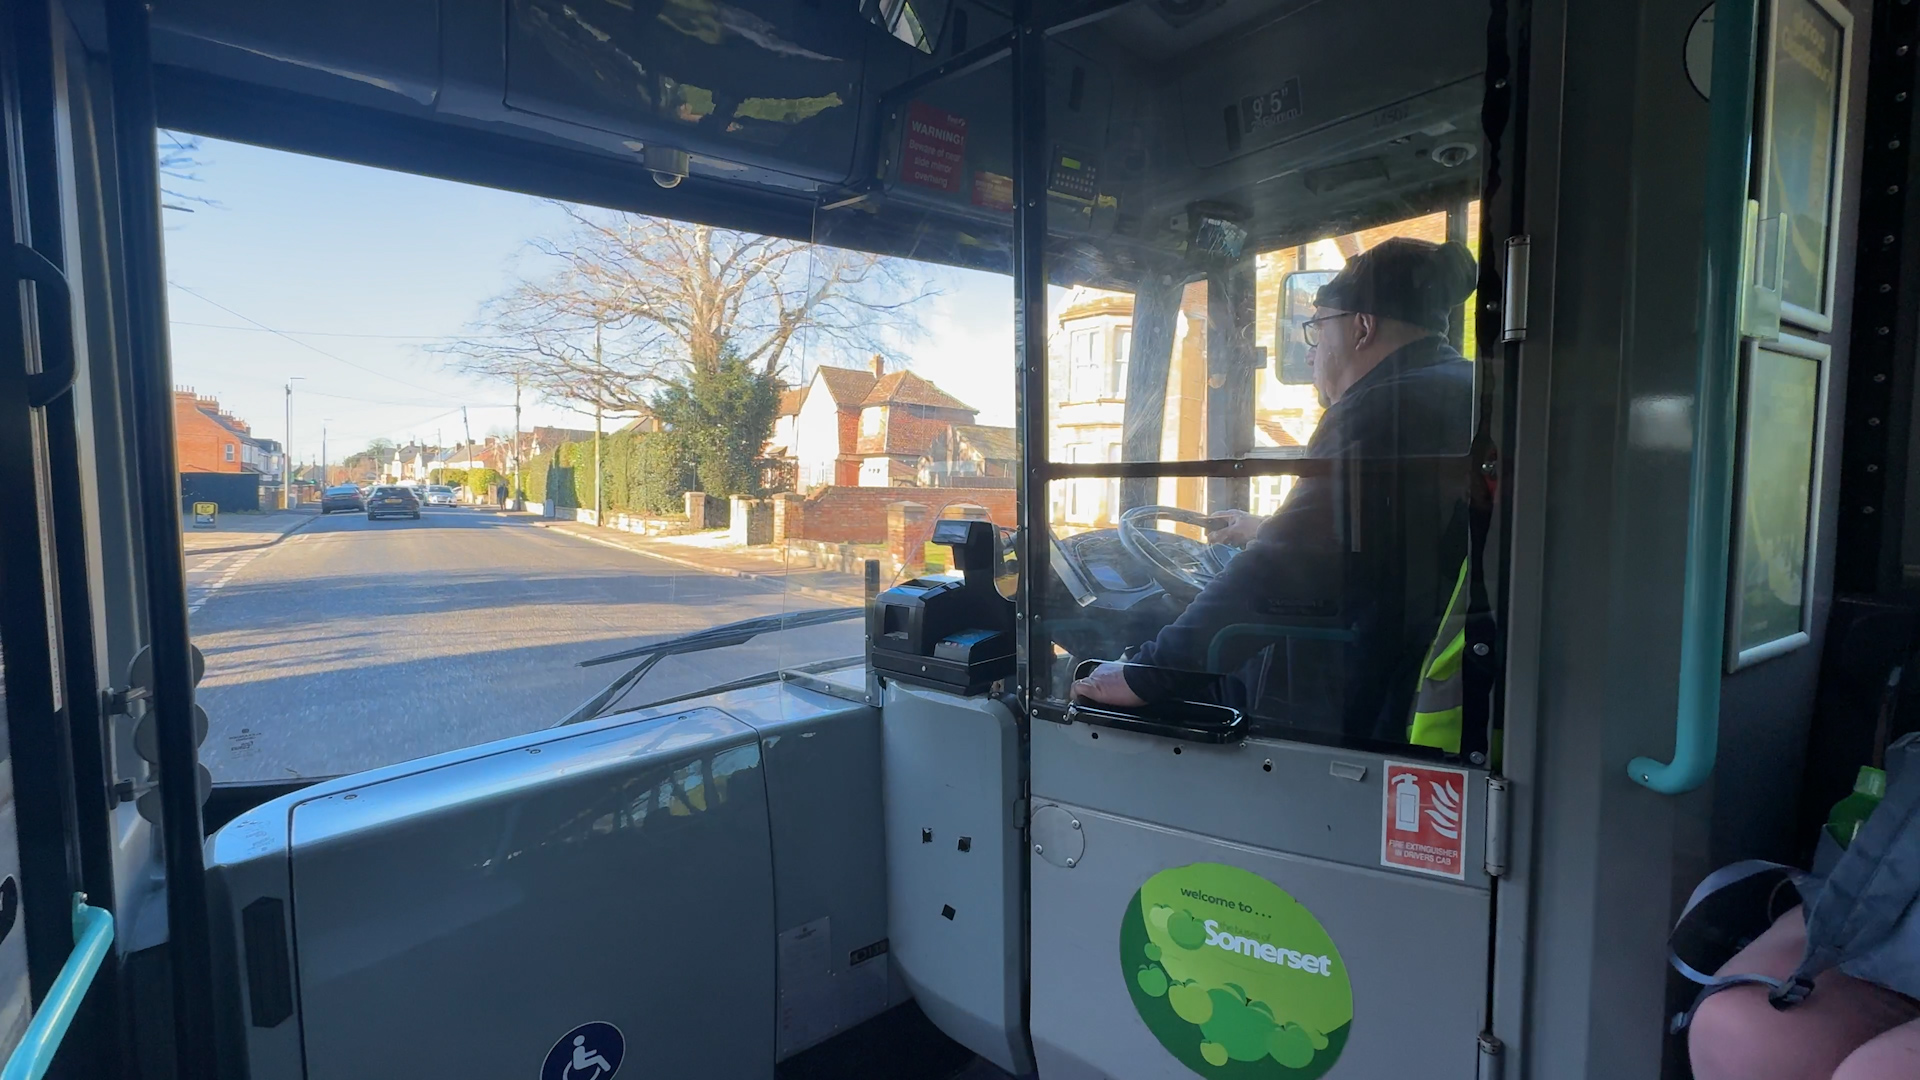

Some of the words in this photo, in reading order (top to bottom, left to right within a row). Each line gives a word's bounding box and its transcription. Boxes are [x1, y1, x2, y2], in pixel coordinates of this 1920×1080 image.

[912, 120, 964, 145] WARNING!
[909, 139, 936, 155] Beware
[936, 148, 945, 158] of
[914, 157, 930, 167] side
[931, 162, 952, 173] mirror
[914, 171, 948, 189] overhang
[1389, 839, 1405, 849] FIRE
[1405, 842, 1458, 858] EXTINGUISHER
[1394, 849, 1403, 857] IN
[1404, 850, 1434, 862] DRIVERS
[1436, 857, 1451, 865] CAB
[1180, 887, 1236, 910] welcome
[1203, 918, 1332, 978] Somerset
